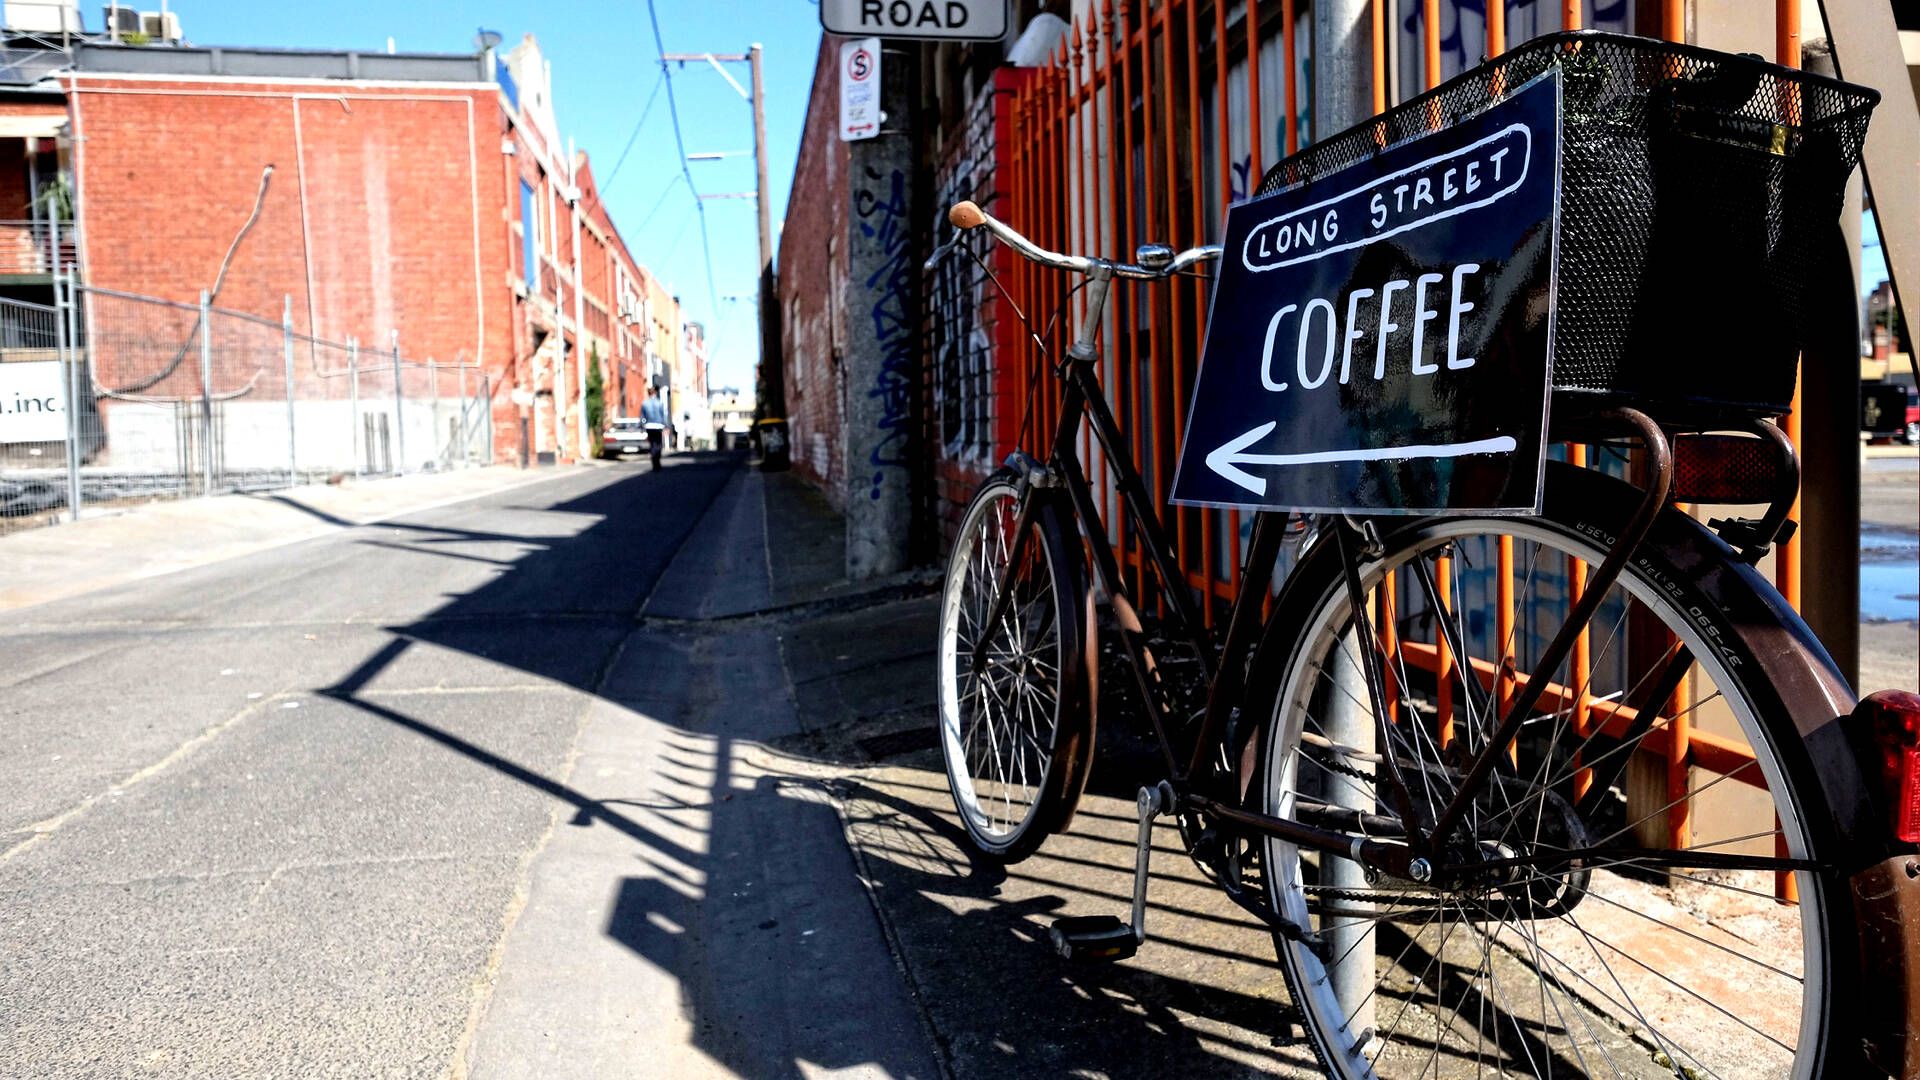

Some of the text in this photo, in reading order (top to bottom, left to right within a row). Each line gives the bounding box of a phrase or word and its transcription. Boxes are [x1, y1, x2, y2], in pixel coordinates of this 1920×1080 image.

[861, 0, 967, 28] ROAD
[1259, 147, 1509, 258] LONG STREET
[1261, 264, 1480, 392] COFFEE
[1689, 606, 1743, 667] 37-590
